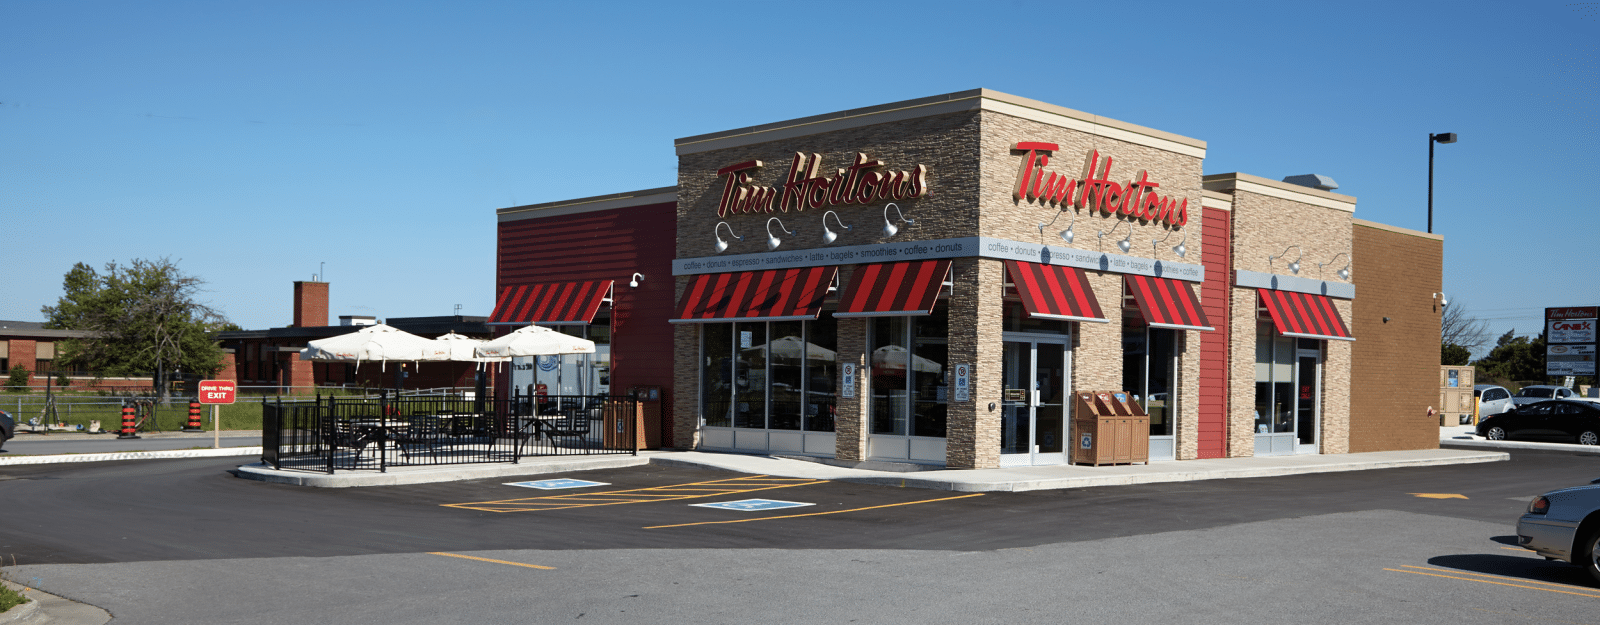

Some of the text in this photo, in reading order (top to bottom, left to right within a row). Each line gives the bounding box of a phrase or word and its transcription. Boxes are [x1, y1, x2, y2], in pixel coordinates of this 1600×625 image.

[717, 151, 926, 218] Tim Hortons
[1010, 141, 1188, 228] Tim Hortons
[683, 243, 963, 271] coffee donuts espresso sandwiches latte bagels smoothies coffee donuts
[988, 243, 1009, 253] coffee
[1014, 245, 1037, 257] donuts
[1113, 258, 1126, 268] latte
[1130, 260, 1149, 271] bagels
[1183, 268, 1199, 277] coffee
